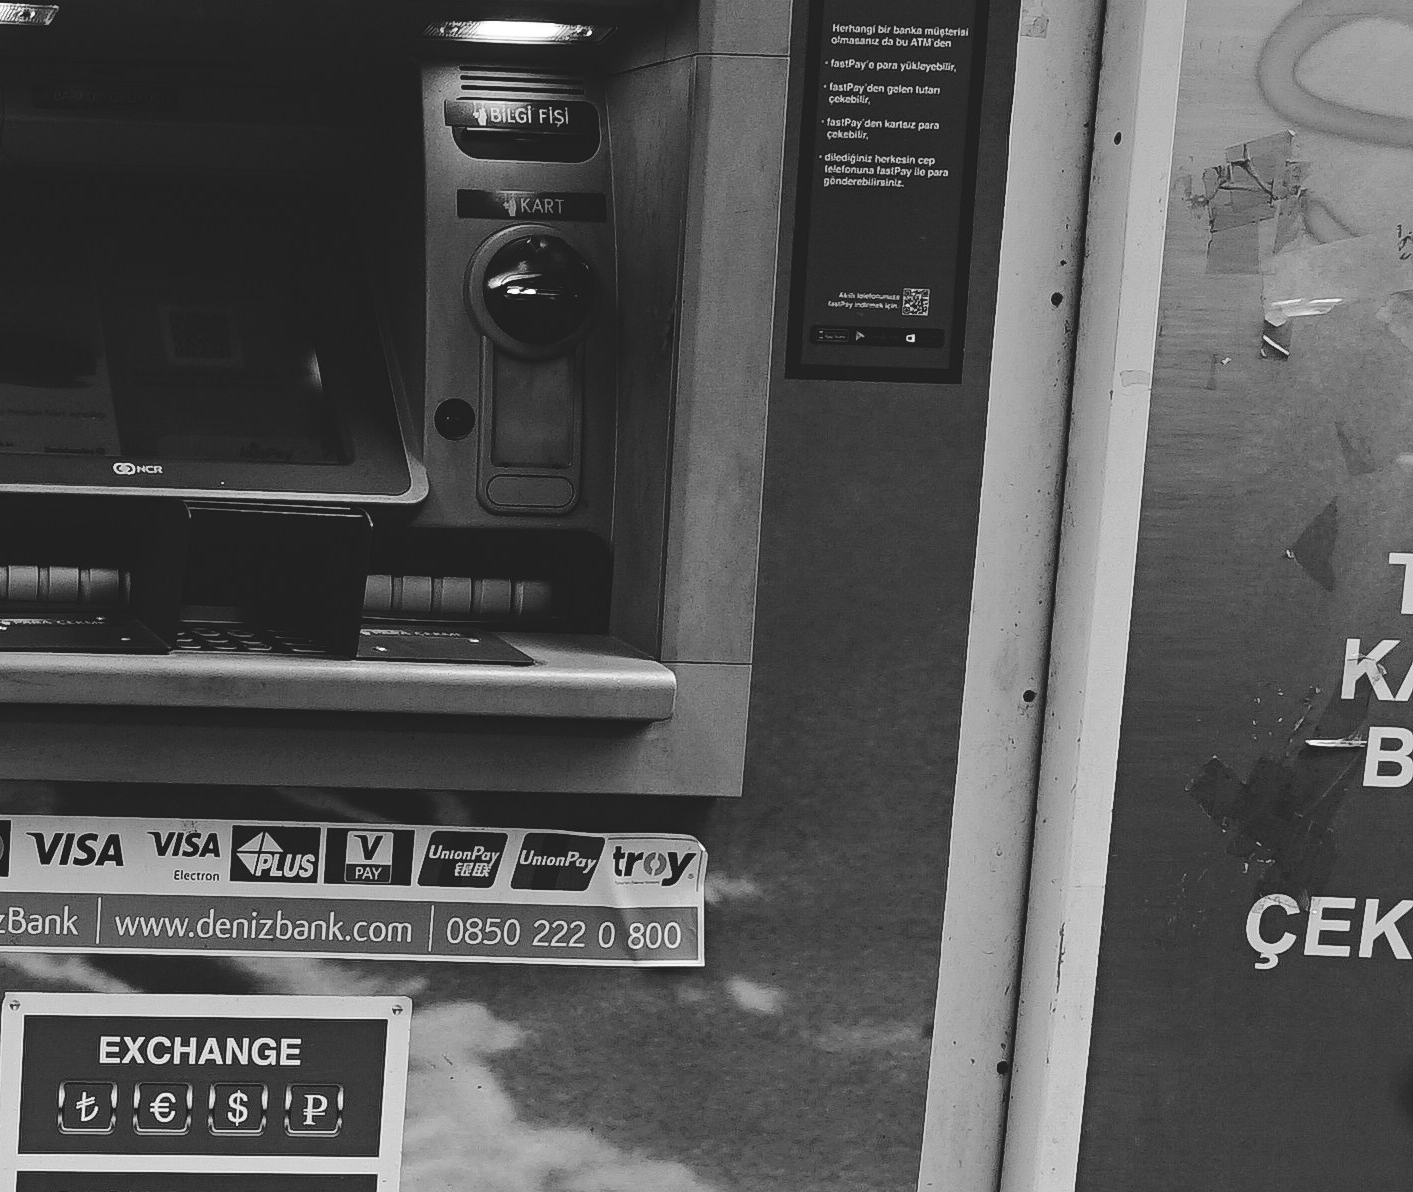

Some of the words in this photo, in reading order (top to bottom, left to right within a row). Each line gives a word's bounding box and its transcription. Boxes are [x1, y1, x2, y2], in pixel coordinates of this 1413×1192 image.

[832, 24, 876, 35] Herhangi
[878, 25, 891, 34] bir
[893, 26, 922, 35] banka
[925, 27, 969, 37] müşterisi
[882, 37, 894, 46] da
[896, 38, 908, 46] bu
[876, 61, 897, 71] para
[887, 85, 913, 95] gelen
[490, 106, 532, 123] BİLGİ
[539, 107, 569, 127] FİŞİ
[918, 122, 940, 131] para
[875, 155, 916, 164] herkesin
[918, 157, 935, 167] cep
[824, 165, 874, 174] telefonuna
[876, 166, 912, 177] fastPay
[927, 168, 949, 178] para
[520, 199, 565, 214] KART
[137, 465, 163, 474] NCR
[1341, 638, 1413, 702] K
[26, 831, 124, 867] VISA
[146, 830, 221, 858] VISA
[353, 834, 385, 860] V
[256, 852, 315, 878] PLUS
[429, 845, 500, 867] UnionPay
[519, 848, 596, 873] UnionPay
[355, 866, 382, 880] PAY
[613, 846, 696, 886] troy
[174, 870, 220, 882] Electron
[116, 907, 412, 943] www.denizbank.com
[447, 917, 520, 945] 0850
[532, 920, 585, 948] 222
[598, 922, 615, 948] 0
[628, 922, 681, 950] 800
[99, 1036, 302, 1066] EXCHANGE
